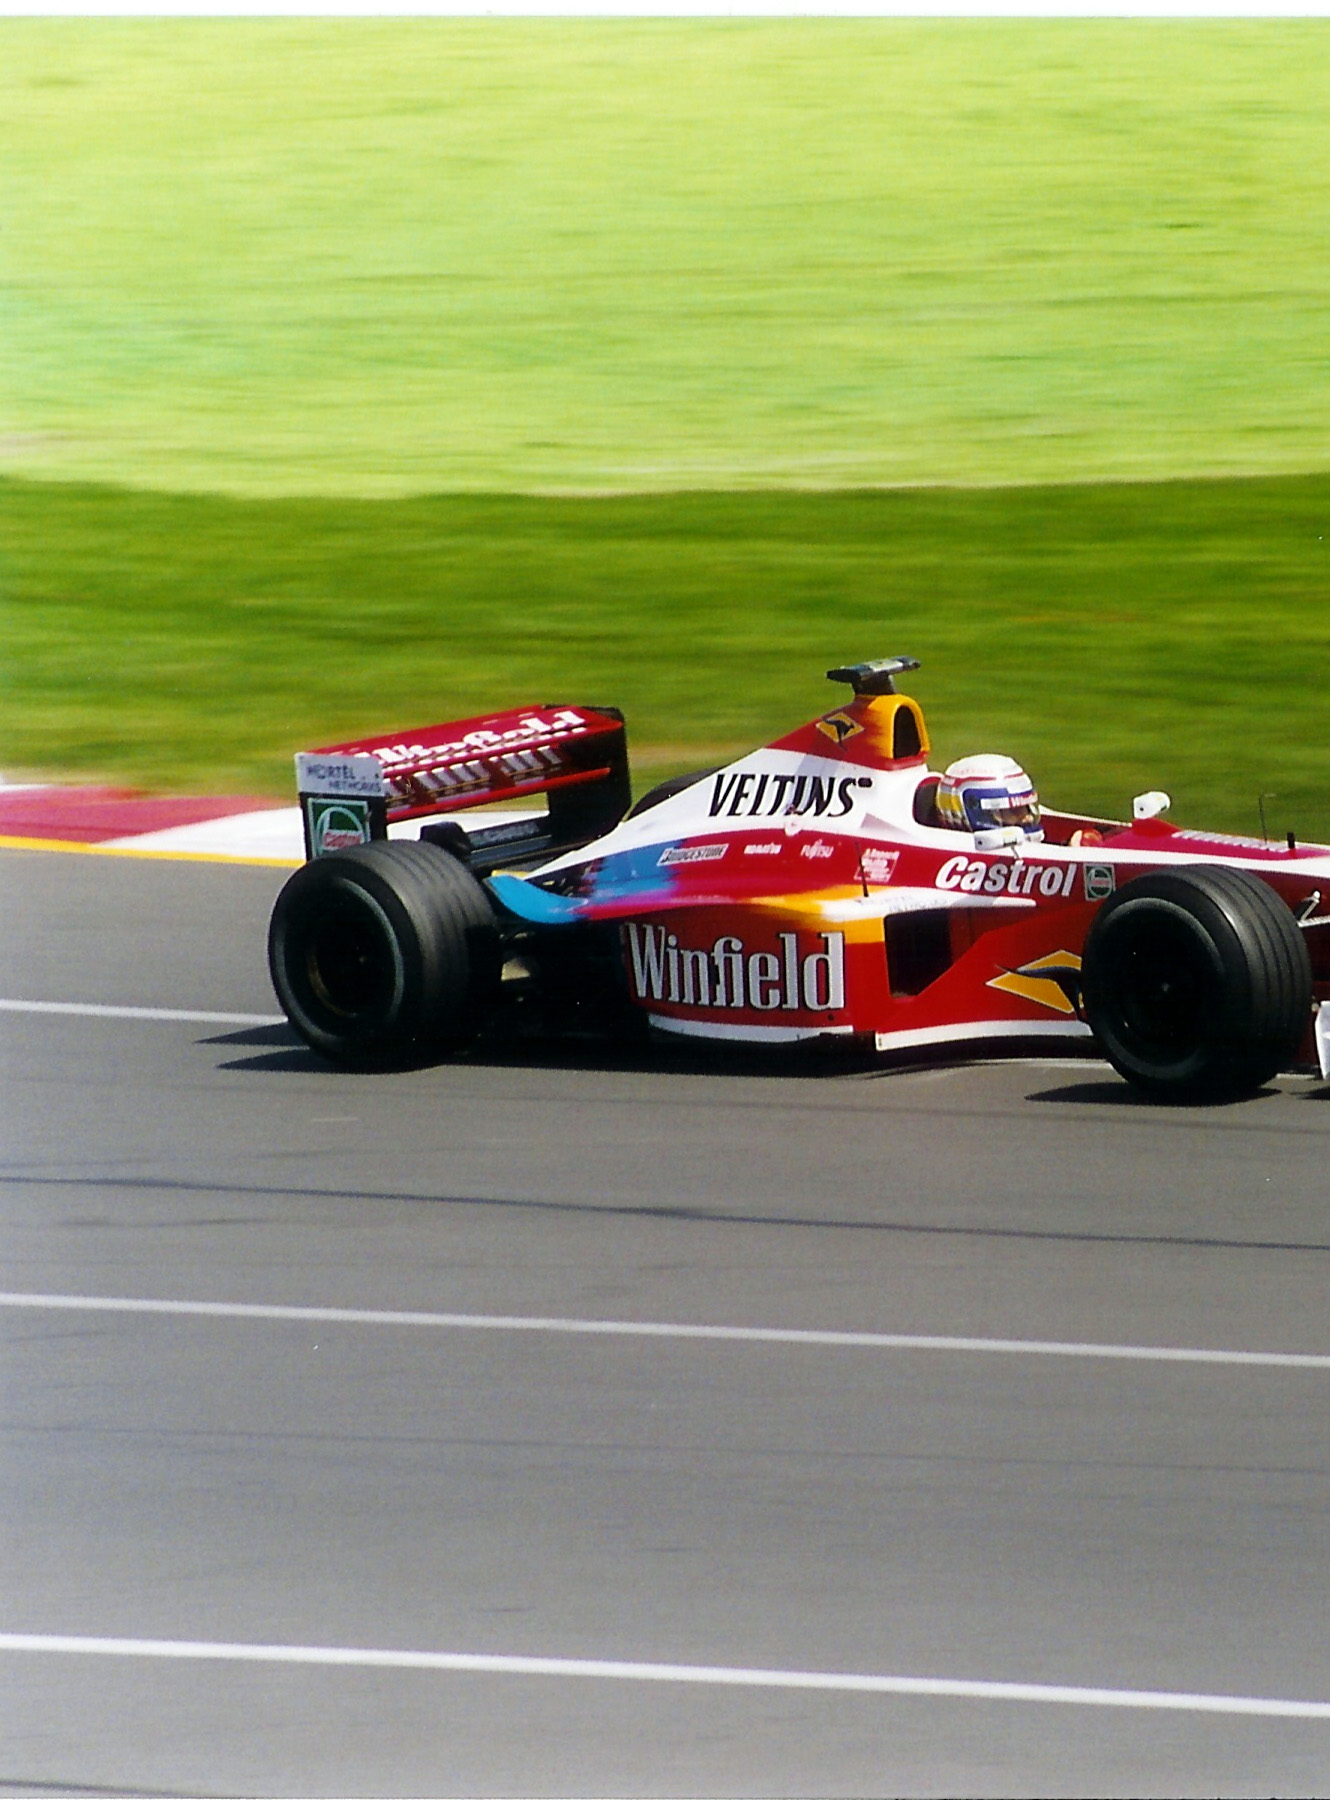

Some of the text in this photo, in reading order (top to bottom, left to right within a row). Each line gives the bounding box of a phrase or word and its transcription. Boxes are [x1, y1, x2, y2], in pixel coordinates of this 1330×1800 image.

[708, 773, 857, 817] VELTINS
[935, 856, 1078, 897] Castrol
[624, 922, 845, 1011] Winfield
